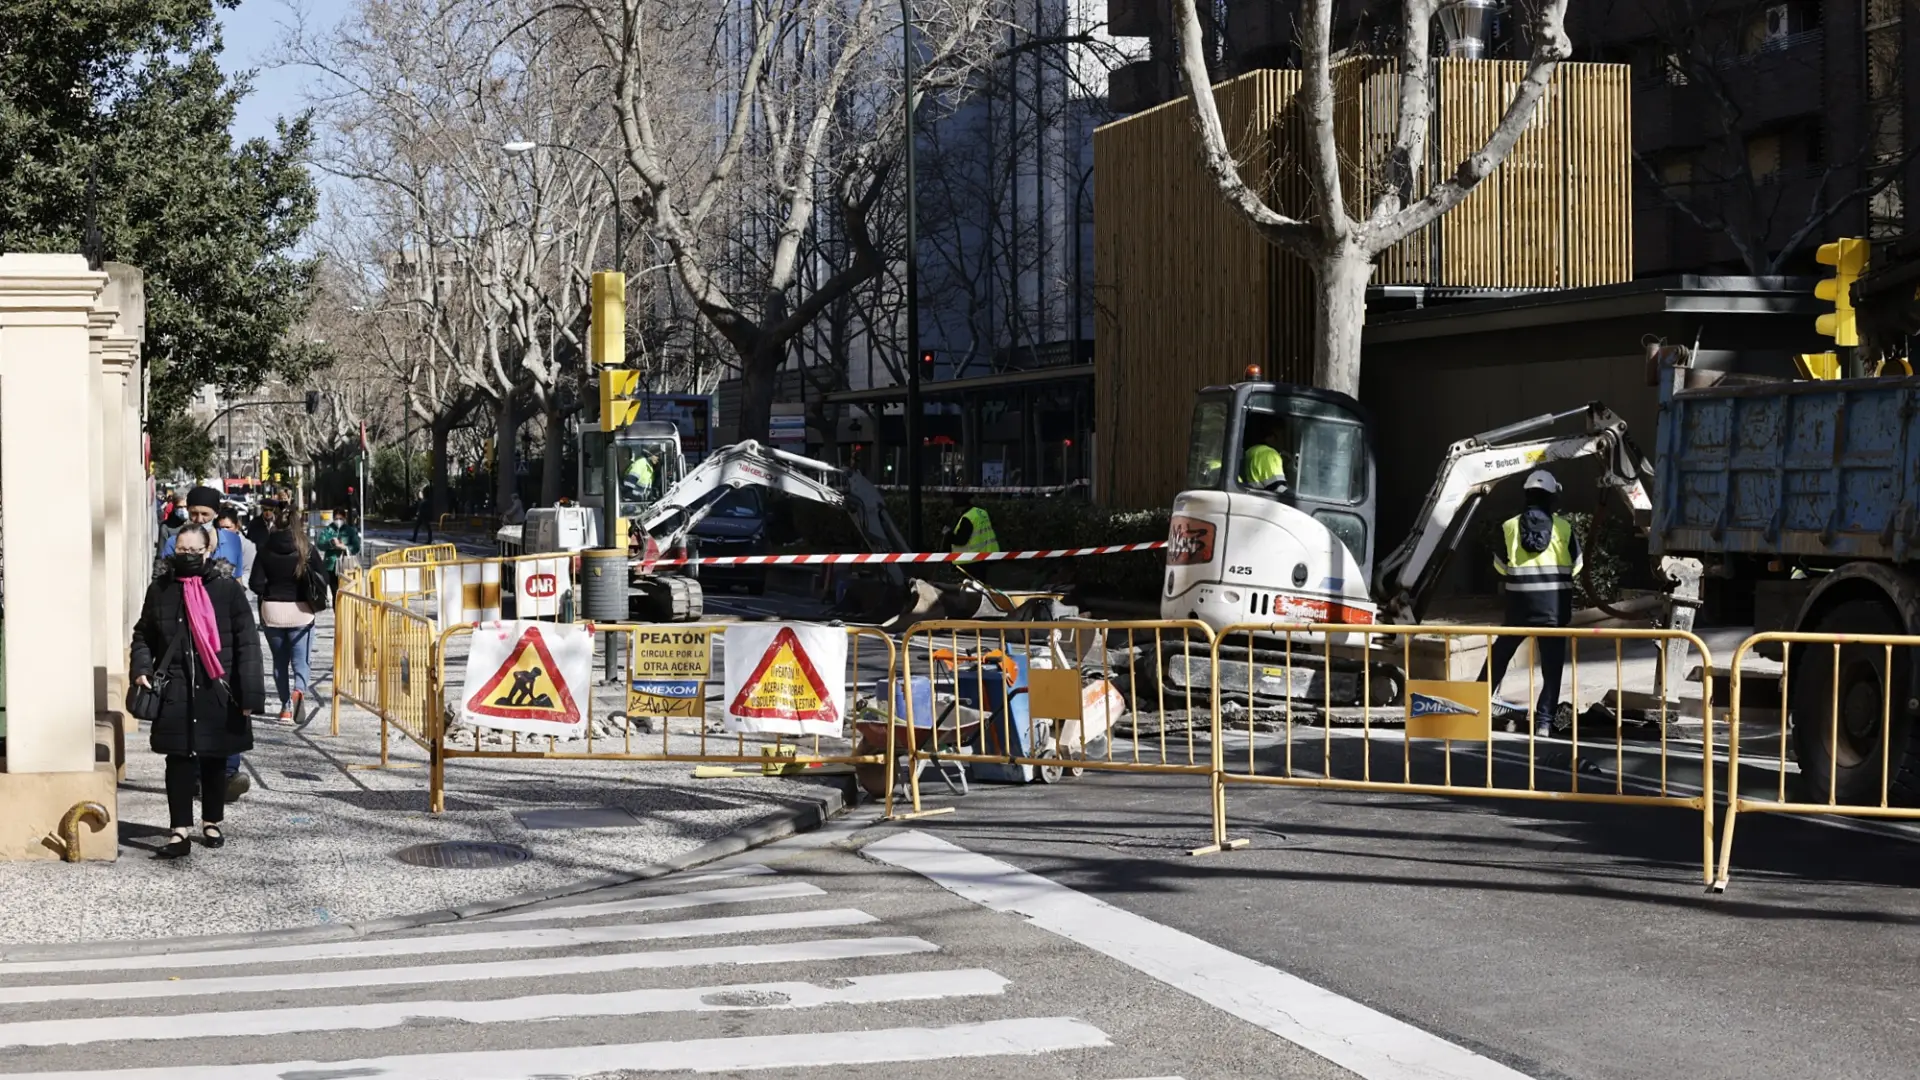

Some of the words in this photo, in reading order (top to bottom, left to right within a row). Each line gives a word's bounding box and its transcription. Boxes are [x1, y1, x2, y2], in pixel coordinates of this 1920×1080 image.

[1496, 457, 1520, 469] Bobcat
[1228, 565, 1253, 575] 425
[640, 631, 705, 644] PEATÓN
[641, 650, 674, 658] CIRCULE
[676, 650, 692, 658] POR
[694, 650, 704, 658] LA
[643, 662, 668, 671] OTRA
[671, 662, 702, 671] ACERA
